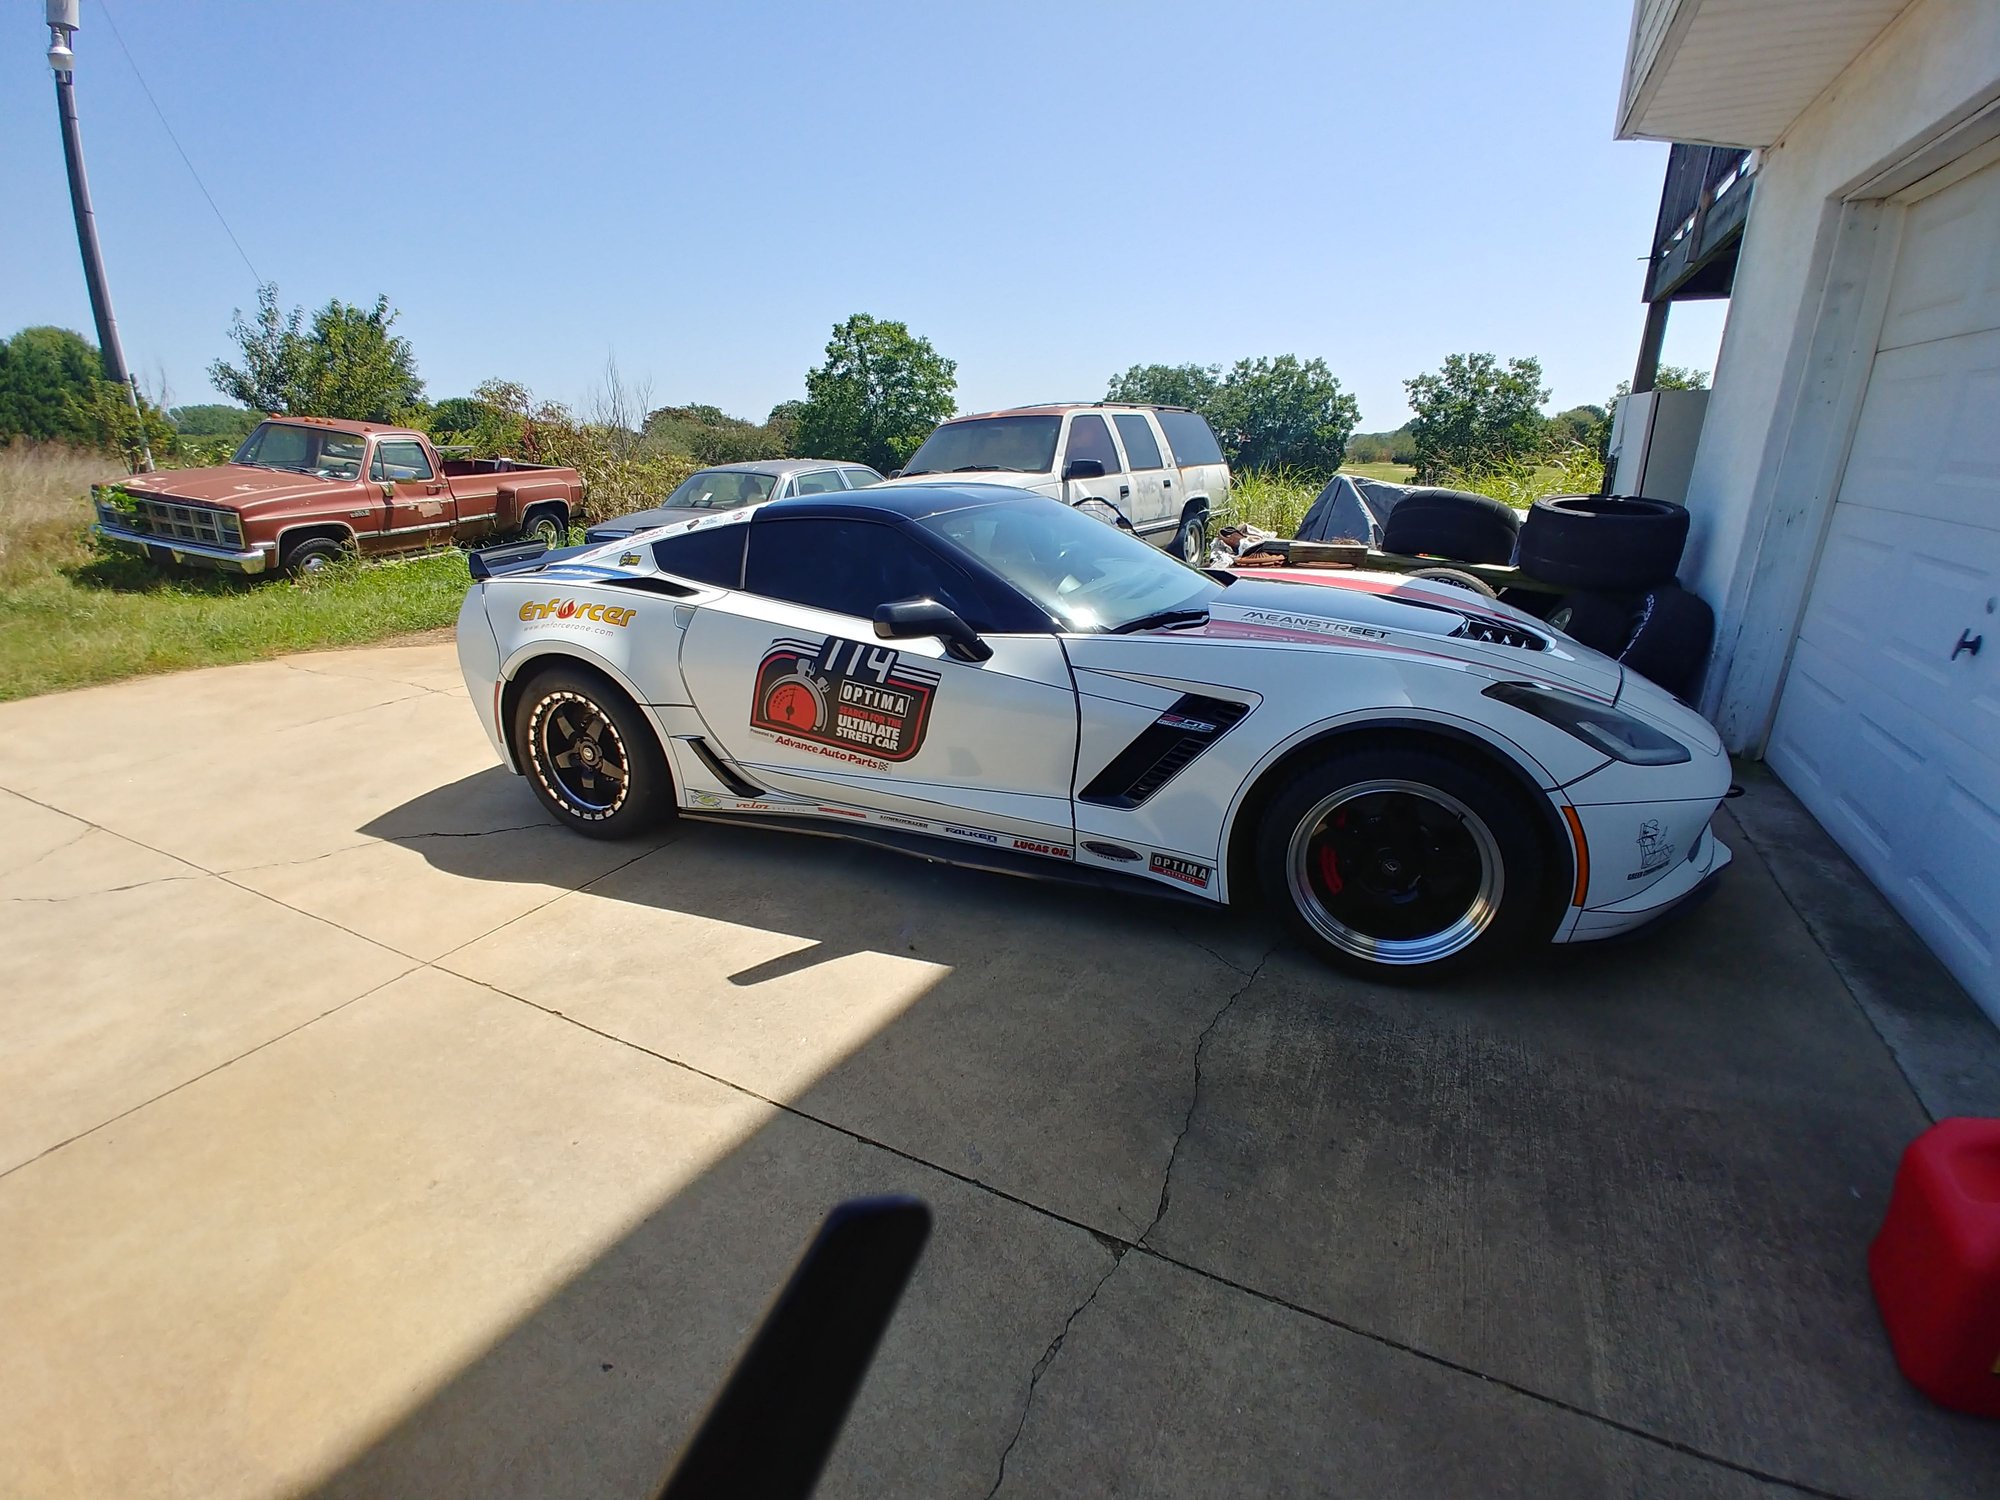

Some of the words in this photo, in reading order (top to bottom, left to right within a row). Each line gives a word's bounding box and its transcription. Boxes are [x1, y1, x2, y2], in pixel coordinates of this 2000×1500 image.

[1243, 611, 1391, 639] MEANSTREET
[825, 639, 896, 684] 114
[842, 684, 905, 713] OPTIMA
[837, 714, 901, 740] ULTIMATE
[839, 705, 869, 719] SEARCH
[869, 713, 886, 724] FOR
[886, 717, 903, 728] THE
[835, 726, 875, 745] STREET
[874, 736, 899, 751] CAR
[775, 735, 819, 753] Advance
[819, 747, 847, 761] Auto
[847, 753, 879, 769] Parts
[945, 827, 998, 843] FALKEN
[1013, 840, 1050, 854] LUCAS
[1051, 847, 1070, 858] OIL
[1153, 856, 1207, 880] OPTIMA
